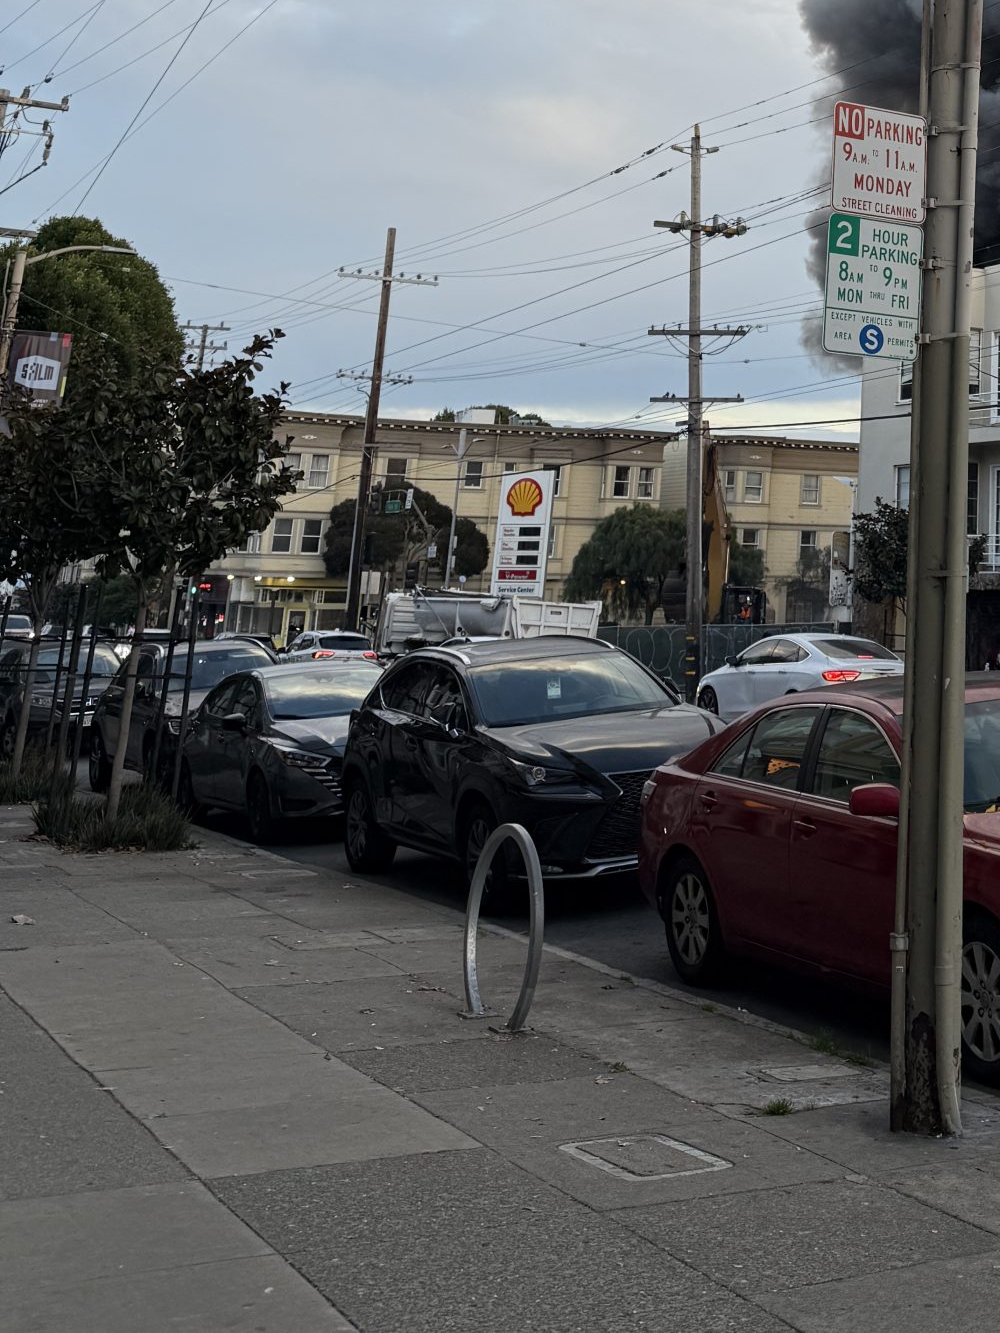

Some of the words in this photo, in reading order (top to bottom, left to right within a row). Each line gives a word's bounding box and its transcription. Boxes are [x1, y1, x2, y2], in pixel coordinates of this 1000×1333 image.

[838, 106, 862, 135] NO
[867, 118, 922, 146] PARKING
[872, 149, 879, 157] TO
[854, 173, 911, 197] MONDAY
[842, 197, 872, 212] STREET
[875, 202, 917, 219] CLEANING
[836, 221, 853, 249] 2
[873, 228, 908, 247] HOUR
[861, 244, 918, 266] PARKING
[870, 265, 878, 273] TO
[837, 287, 863, 304] MON
[870, 291, 885, 300] THRU
[891, 294, 910, 309] FRI
[831, 312, 856, 322] EXCEPT
[861, 316, 893, 327] VEHICLES
[898, 320, 913, 329] WITH
[834, 331, 852, 340] AREA
[864, 328, 878, 350] S
[887, 337, 914, 348] PERMITS
[498, 586, 516, 594] Service
[517, 586, 535, 594] Center
